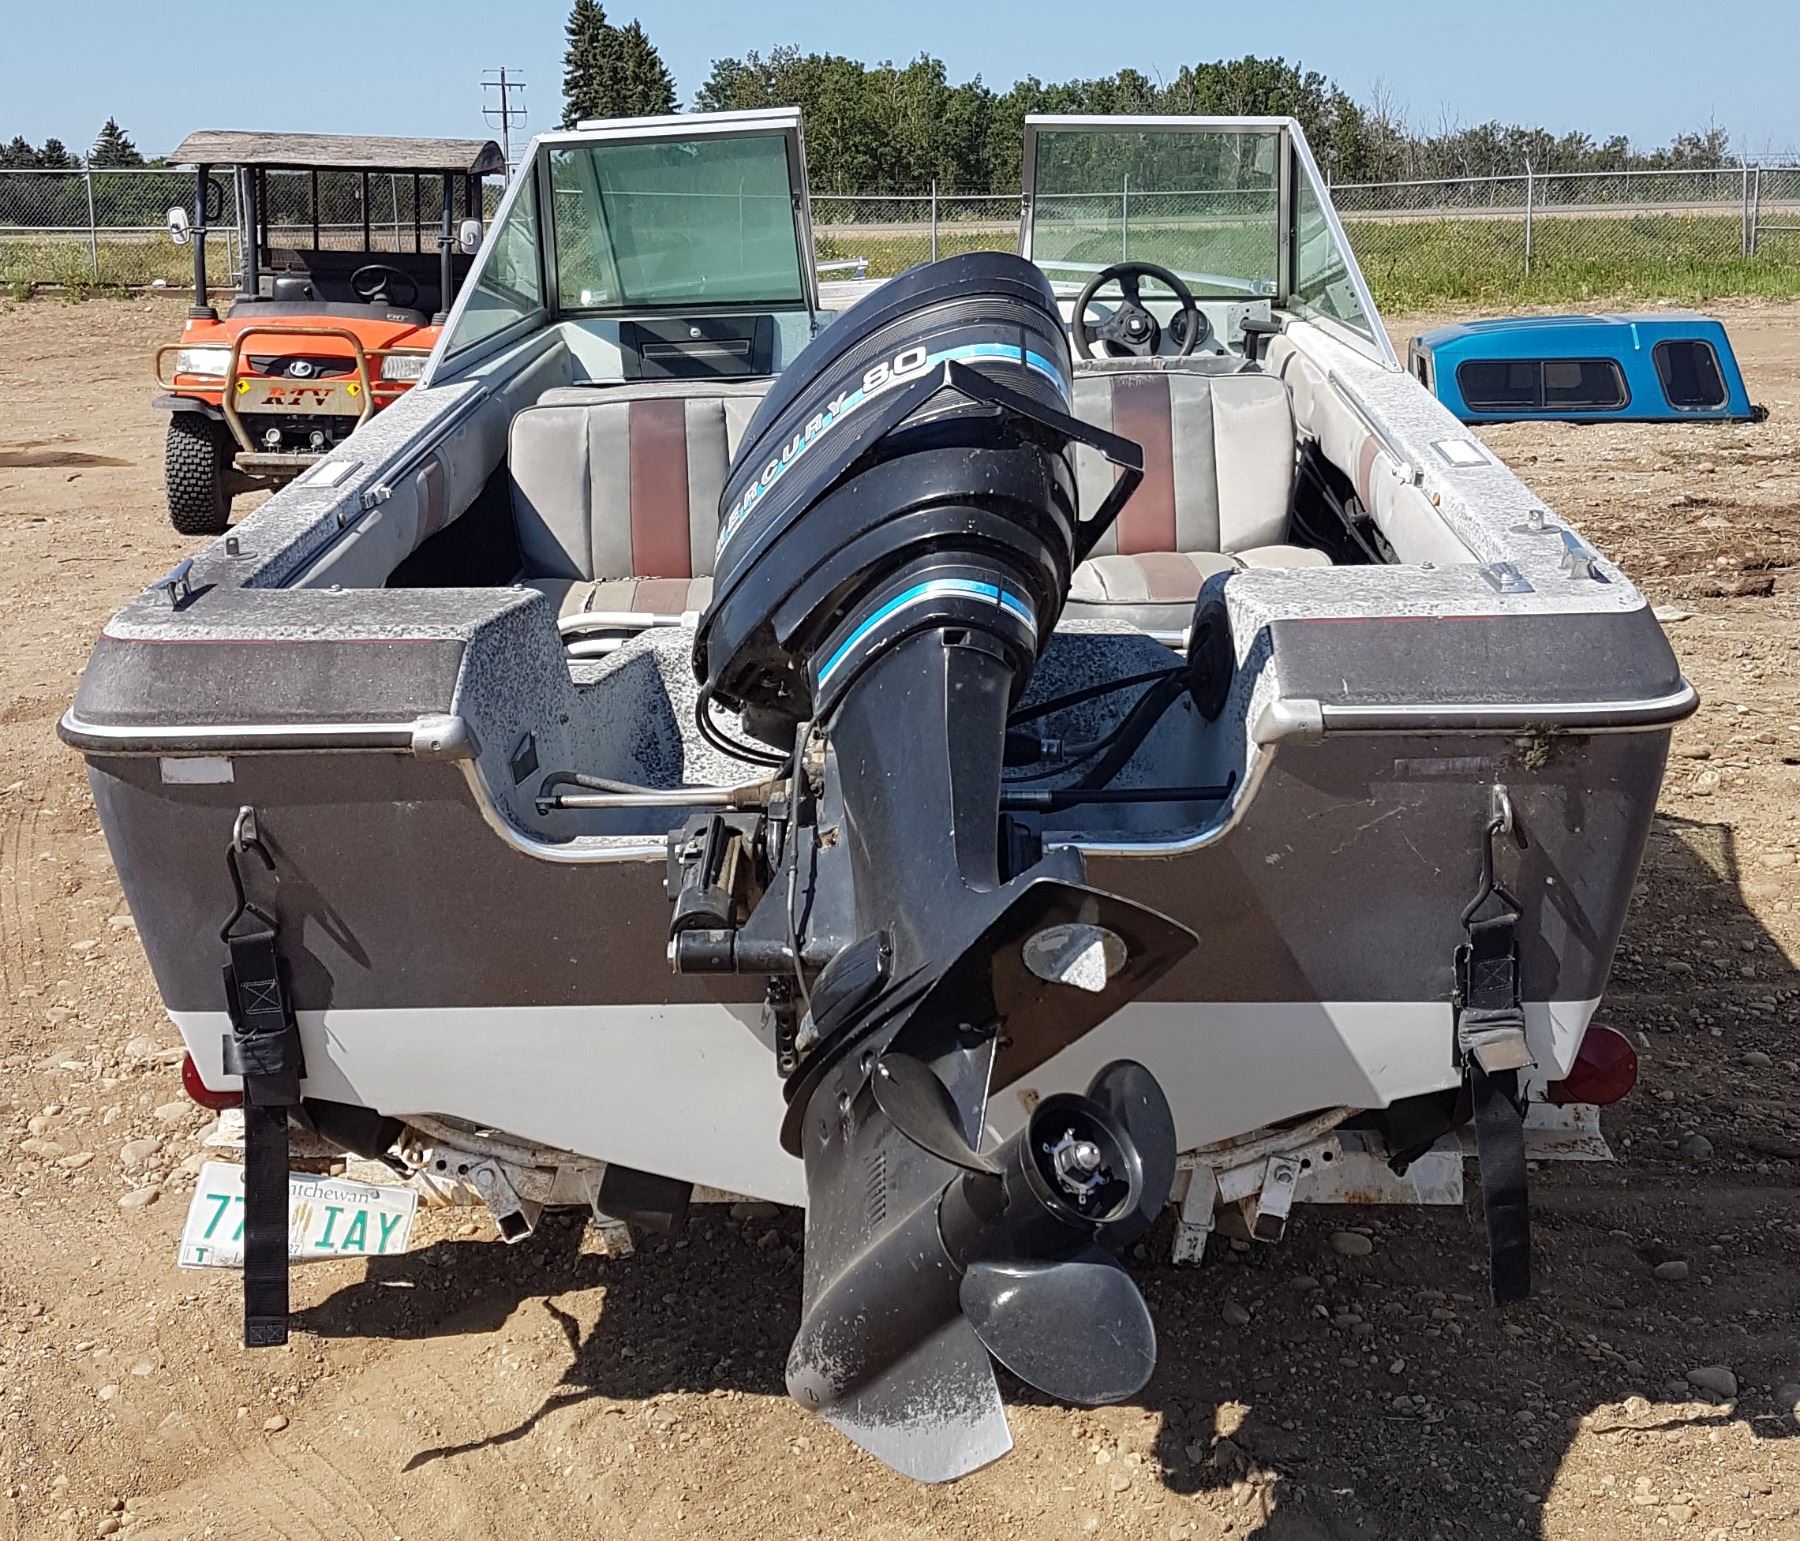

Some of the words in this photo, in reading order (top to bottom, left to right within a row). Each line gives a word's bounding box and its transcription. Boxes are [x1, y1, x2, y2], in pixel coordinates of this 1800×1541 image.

[861, 346, 928, 393] 80
[261, 387, 335, 407] RTV
[314, 1205, 402, 1254] IAY
[195, 1247, 208, 1262] T
